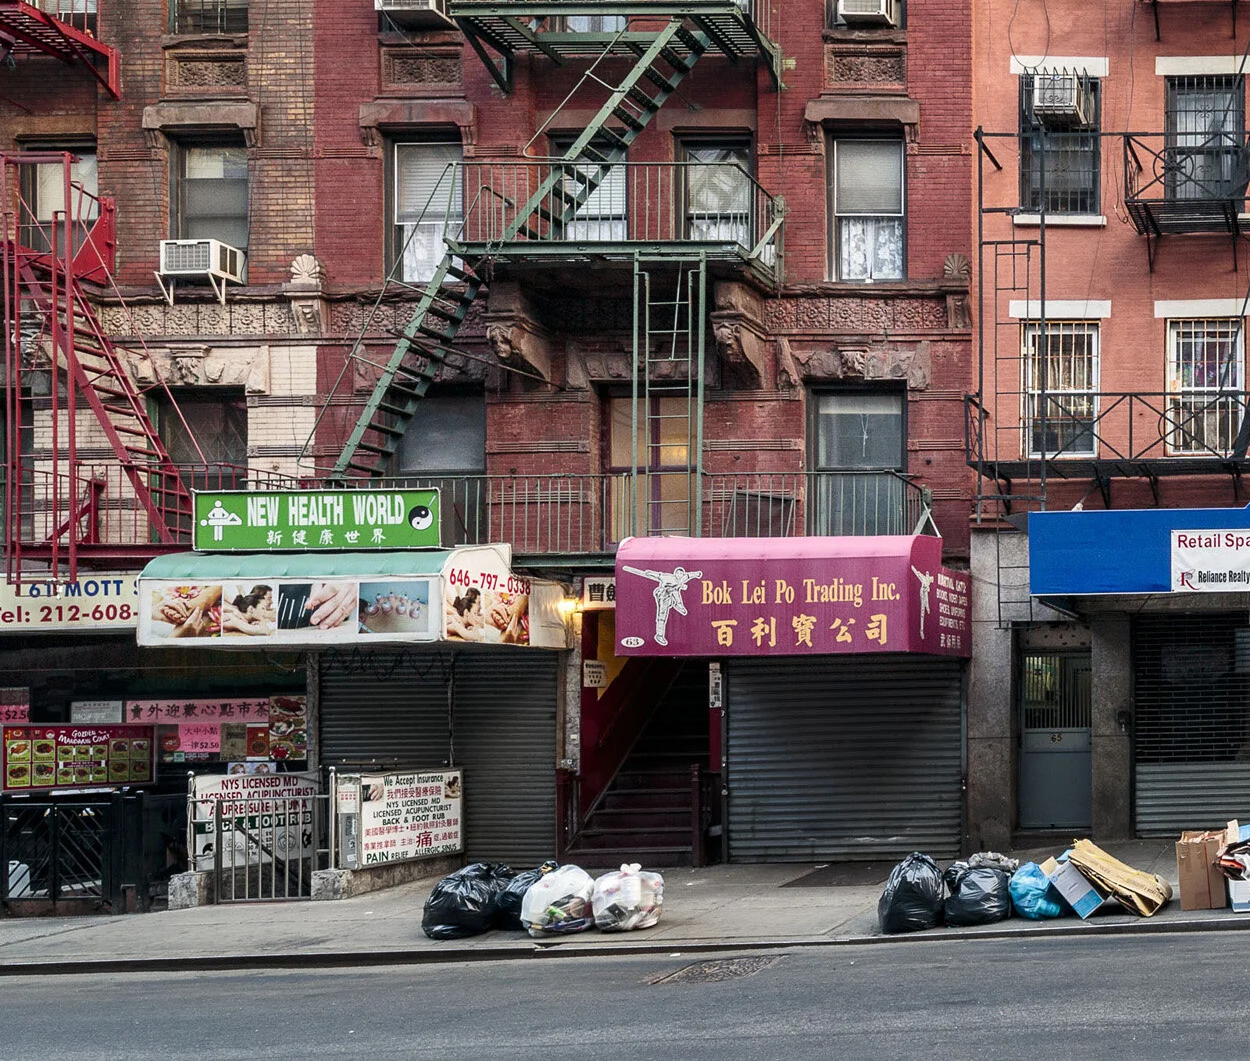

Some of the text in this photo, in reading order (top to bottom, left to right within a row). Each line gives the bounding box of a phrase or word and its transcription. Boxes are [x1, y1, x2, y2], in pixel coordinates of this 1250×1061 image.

[247, 494, 405, 526] NEW HEALTH WORLD
[266, 528, 386, 546] 新健康世界
[1178, 533, 1220, 548] Retail
[450, 568, 530, 595] 646-797-0338
[1198, 570, 1227, 583] Reliance
[1228, 570, 1250, 584] Realty
[65, 580, 123, 597] MOTT
[702, 577, 900, 608] Bok Lei Po Trading Inc.
[0, 604, 138, 623] el: 212-608-
[200, 741, 219, 749] $2.50
[221, 776, 298, 790] NYS LICENSED MD
[384, 773, 443, 787] We Accept Insurance
[201, 787, 314, 804] LICENSED ACUPUNCTURIST
[373, 804, 452, 819] LICENSED ACUPUNCTURIST
[386, 801, 399, 809] NYS
[402, 799, 428, 808] LICENSED
[383, 817, 400, 825] BACK
[366, 843, 457, 864] PAIN RELIEF ALLERGIC SINUS
